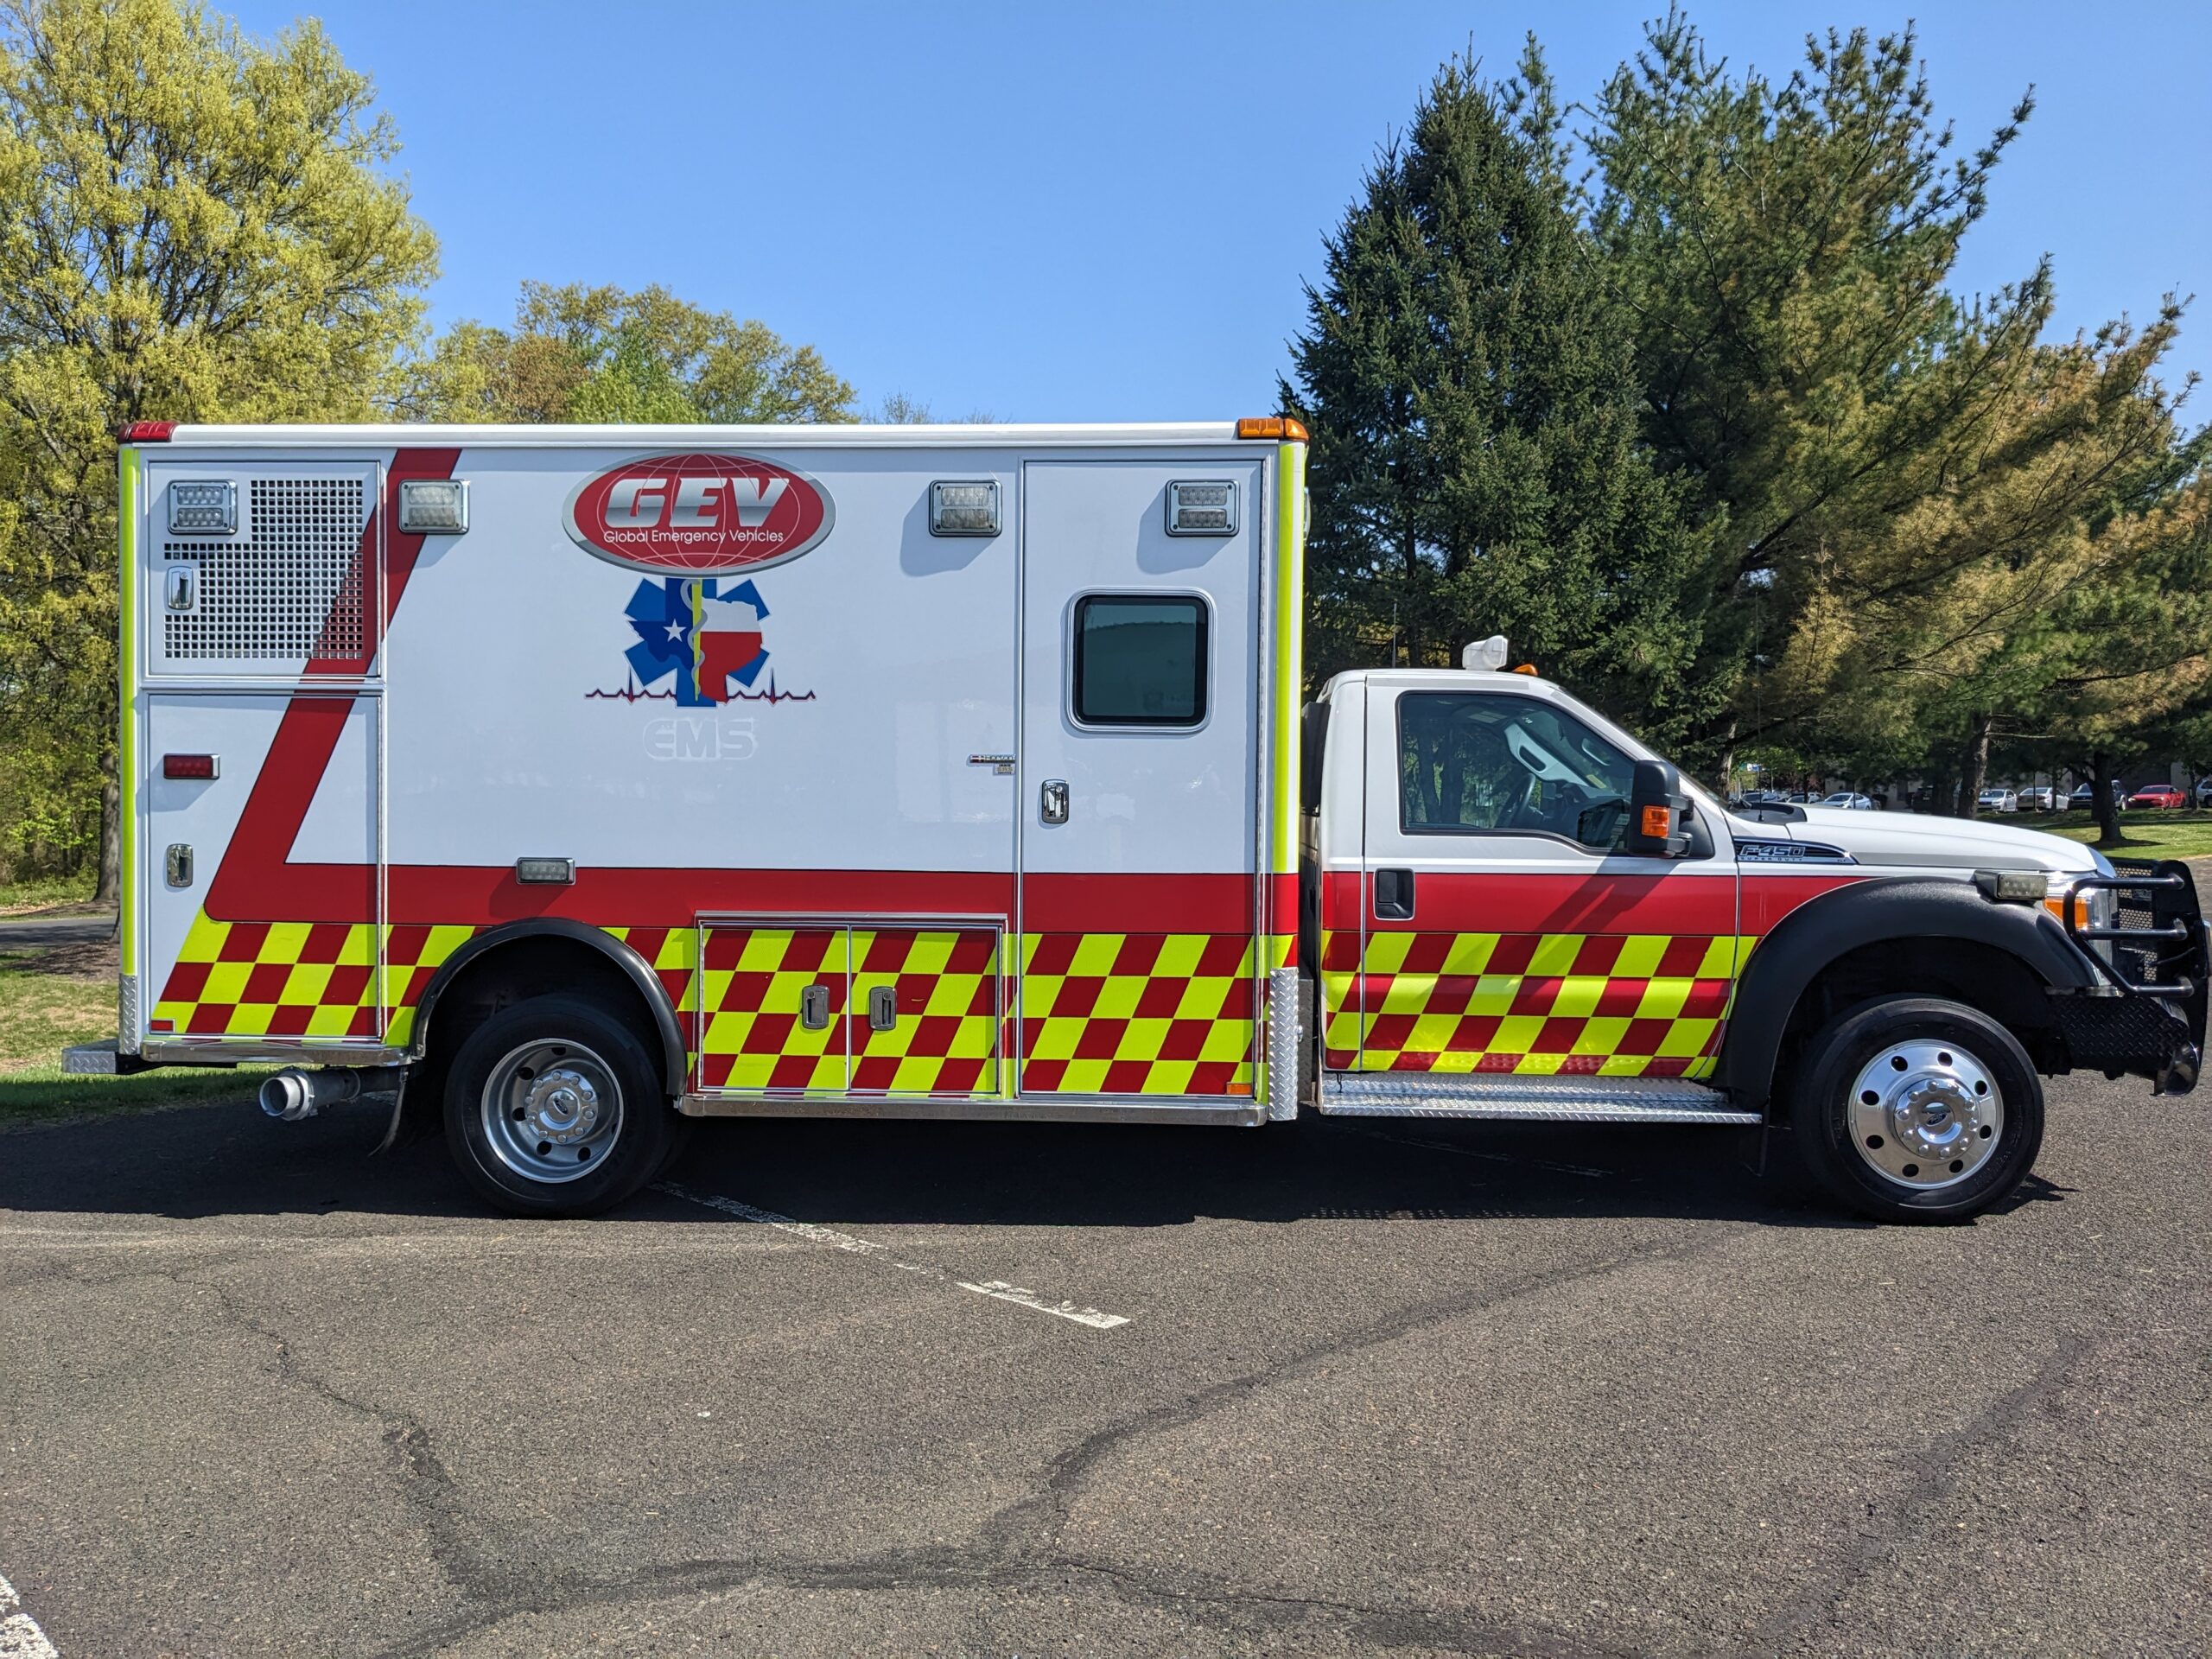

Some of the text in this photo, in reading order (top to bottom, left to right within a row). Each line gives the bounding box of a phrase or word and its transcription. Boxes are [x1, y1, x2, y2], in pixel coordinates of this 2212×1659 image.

[605, 477, 790, 528] GEV
[603, 529, 784, 544] Global Emergency Vehicles
[642, 717, 758, 761] EMS
[1739, 844, 1806, 857] F-450
